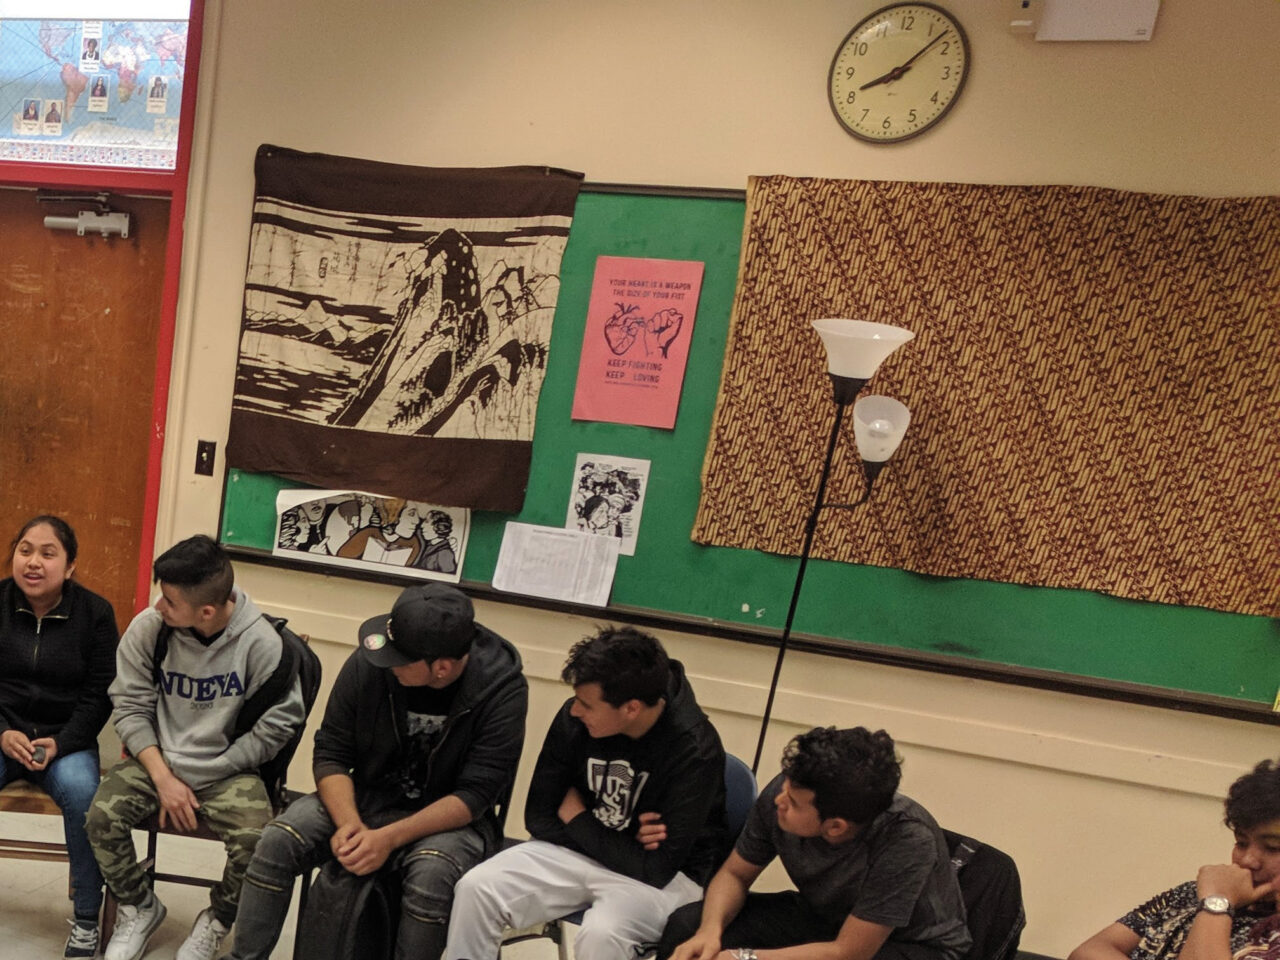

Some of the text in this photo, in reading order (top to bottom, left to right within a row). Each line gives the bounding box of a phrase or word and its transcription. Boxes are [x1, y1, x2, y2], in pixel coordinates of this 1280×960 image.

[901, 16, 914, 31] 12
[876, 25, 888, 38] 11
[928, 24, 934, 37] 1
[853, 42, 868, 56] 10
[940, 42, 950, 55] 2
[846, 67, 855, 80] 9
[941, 66, 951, 80] 3
[846, 91, 856, 104] 8
[930, 91, 939, 104] 4
[861, 108, 870, 122] 7
[907, 109, 916, 123] 5
[882, 116, 891, 129] 6
[665, 282, 691, 290] WEAPON
[607, 359, 663, 371] KEEP FIGHTING
[606, 370, 660, 383] KEEP LOVING
